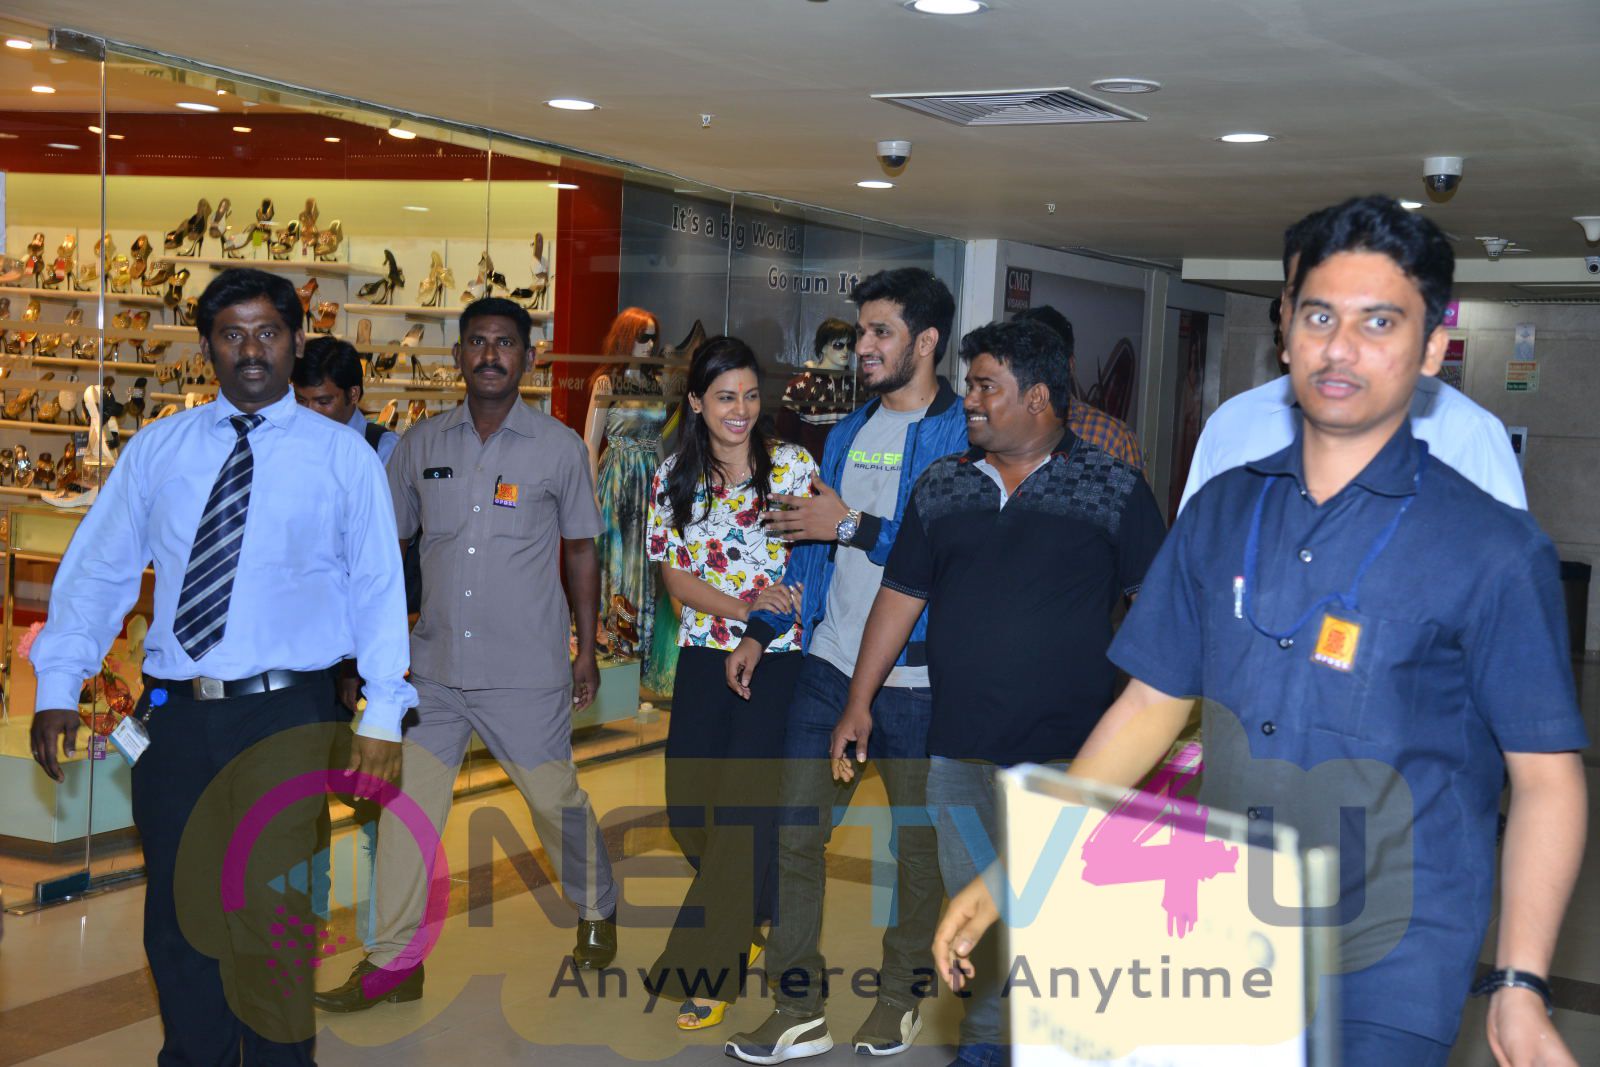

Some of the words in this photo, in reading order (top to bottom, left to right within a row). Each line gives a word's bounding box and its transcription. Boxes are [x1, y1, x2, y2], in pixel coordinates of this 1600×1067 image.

[672, 204, 699, 233] It's
[705, 216, 714, 238] a
[721, 213, 746, 249] big
[768, 264, 788, 290] Go
[793, 273, 829, 294] run
[1008, 270, 1030, 291] CMR
[557, 376, 585, 391] wear
[854, 463, 883, 472] RALPH
